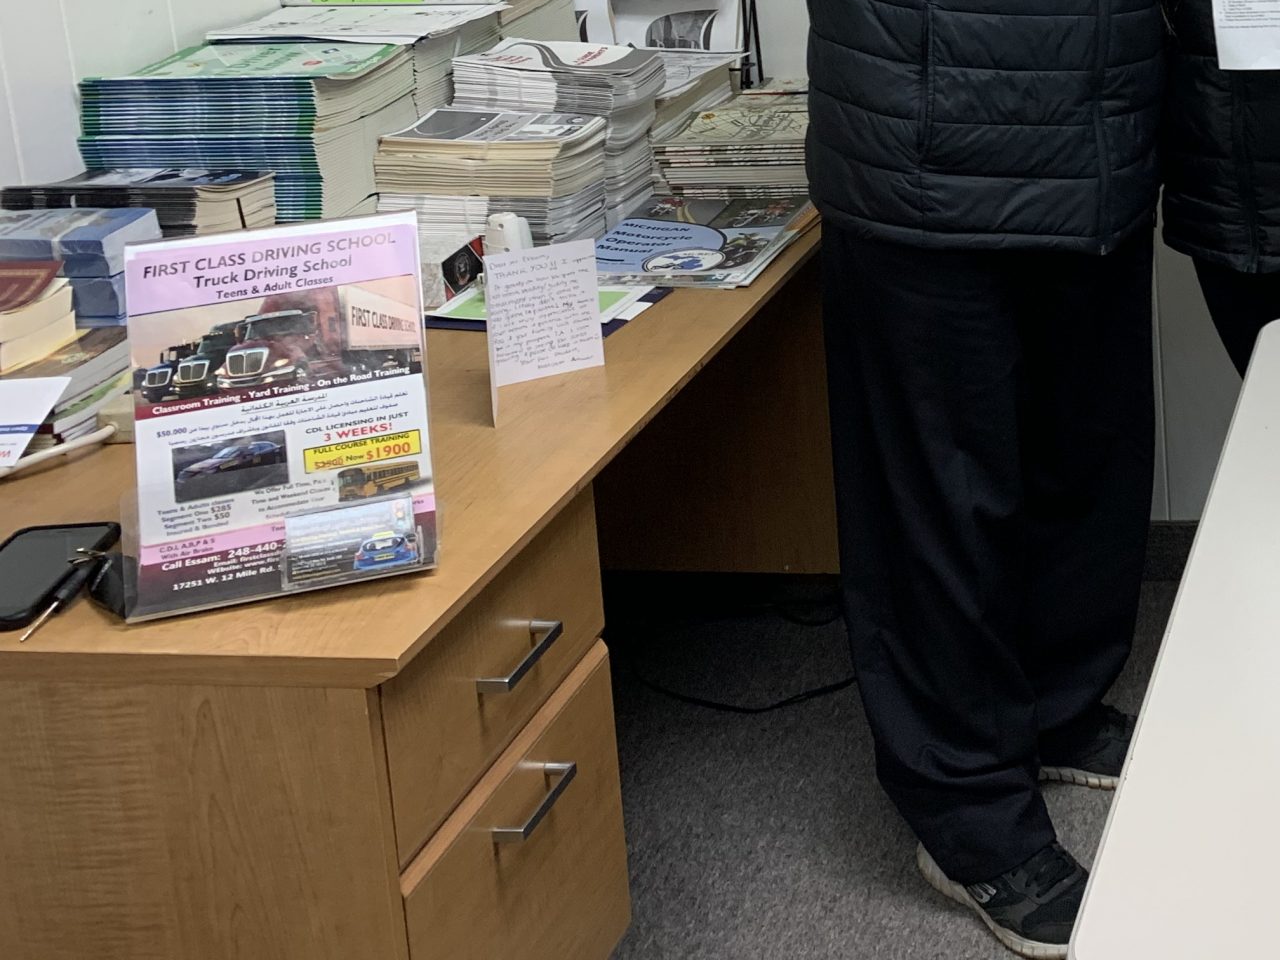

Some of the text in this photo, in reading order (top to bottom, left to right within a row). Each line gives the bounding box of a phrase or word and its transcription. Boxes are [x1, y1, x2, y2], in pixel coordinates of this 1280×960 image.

[612, 230, 693, 241] Motorcycle
[622, 222, 691, 232] MICHIGAN
[596, 244, 654, 253] Manual
[605, 237, 673, 247] Operator
[143, 232, 396, 279] FIRST CLASS DRIVING SCHOOL
[193, 254, 352, 289] Truck Driving School
[216, 275, 334, 300] Teens & Adult Classes
[352, 306, 370, 327] FIRST
[152, 401, 201, 415] Classroom
[202, 394, 241, 407] Training
[248, 386, 271, 399] Yard
[273, 382, 309, 395] Training
[317, 379, 332, 387] On
[333, 376, 348, 385] the
[349, 371, 373, 382] Road
[374, 366, 410, 378] Training
[305, 426, 323, 434] CDL
[326, 418, 374, 431] LICENSING
[389, 411, 409, 421] JUST
[324, 422, 393, 442] 3 WEEKS!
[313, 433, 410, 455] FULL COURSE TRAINING
[345, 442, 411, 462] Now $1900
[211, 504, 232, 515] $285
[214, 512, 231, 521] $50
[161, 542, 287, 571] Call Essam: 248-440-2
[213, 557, 238, 568] Email:
[244, 557, 280, 568] www.firs
[172, 566, 276, 591] 17251 W. 12 Mile Rd.
